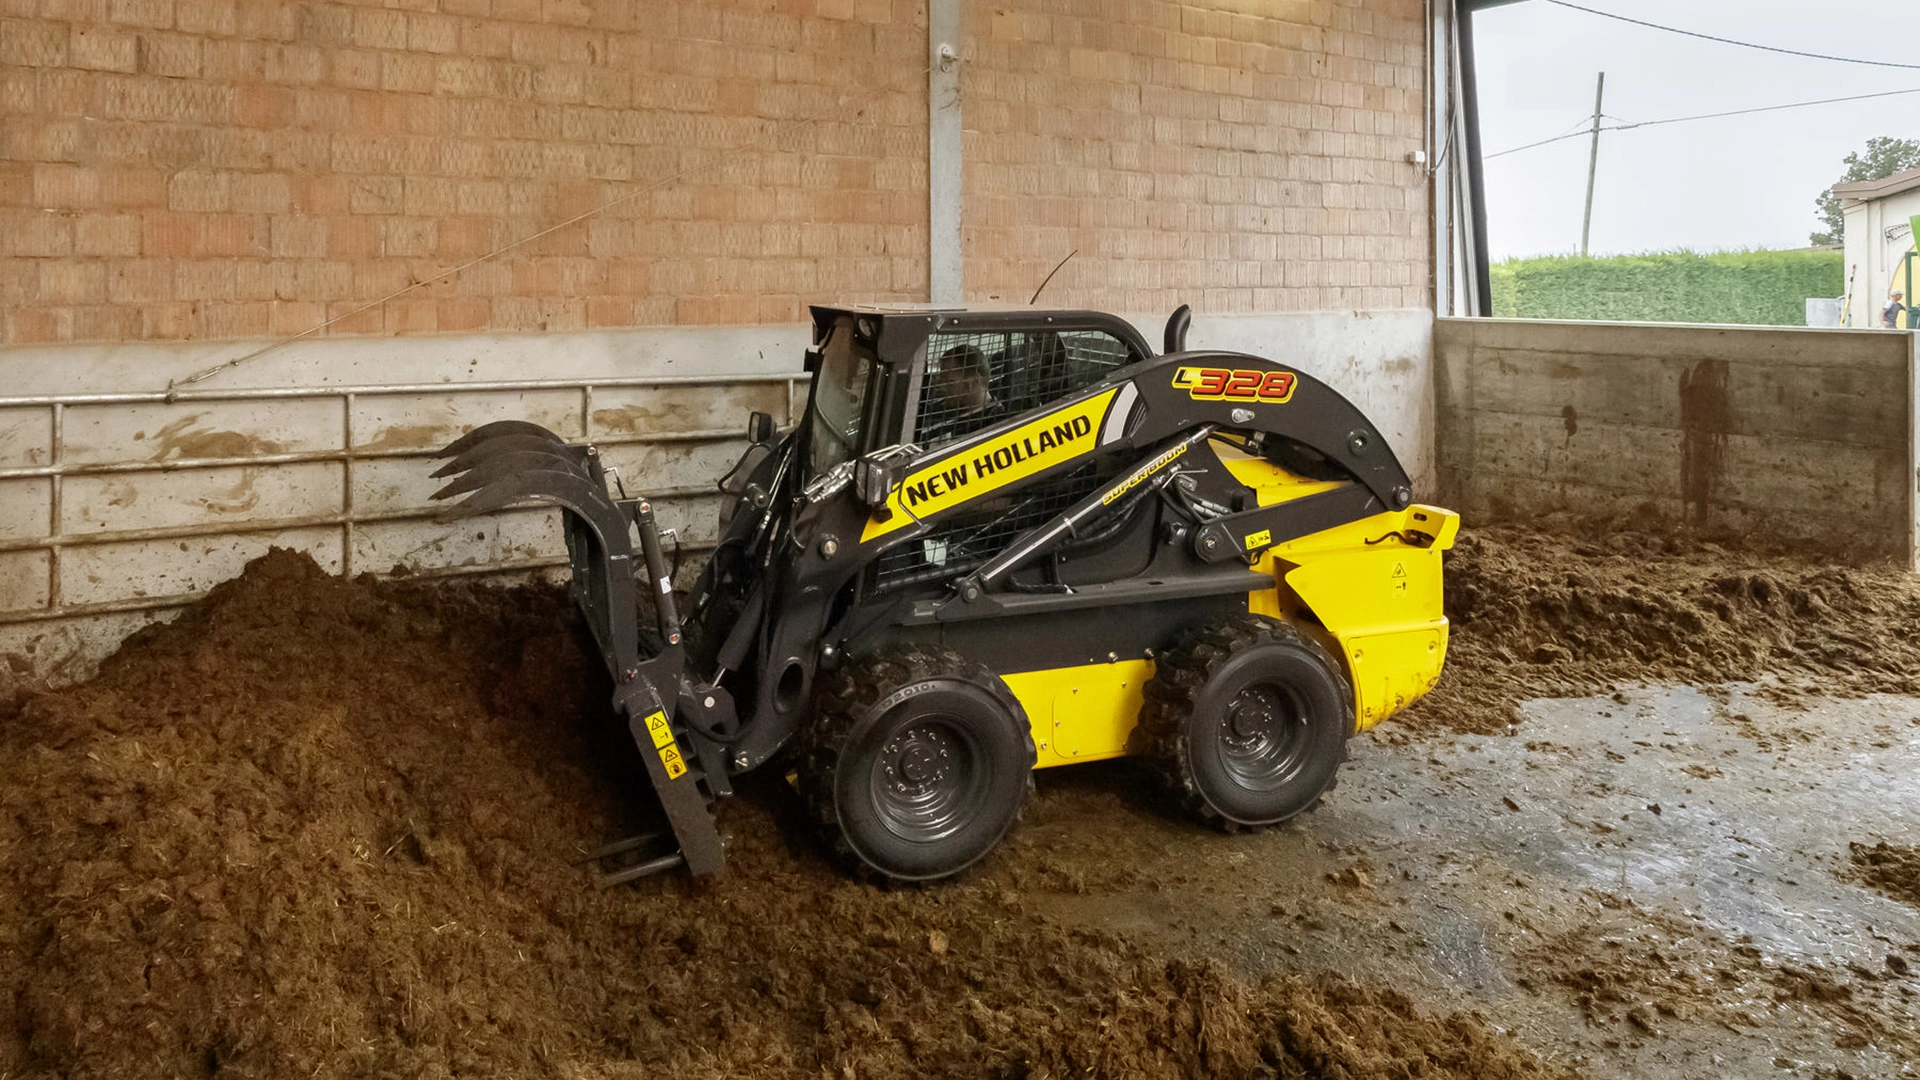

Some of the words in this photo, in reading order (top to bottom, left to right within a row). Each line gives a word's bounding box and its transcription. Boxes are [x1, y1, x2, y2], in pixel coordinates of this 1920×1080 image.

[1173, 367, 1296, 401] L328
[906, 464, 968, 507] NEW
[973, 415, 1091, 478] HOLLAND
